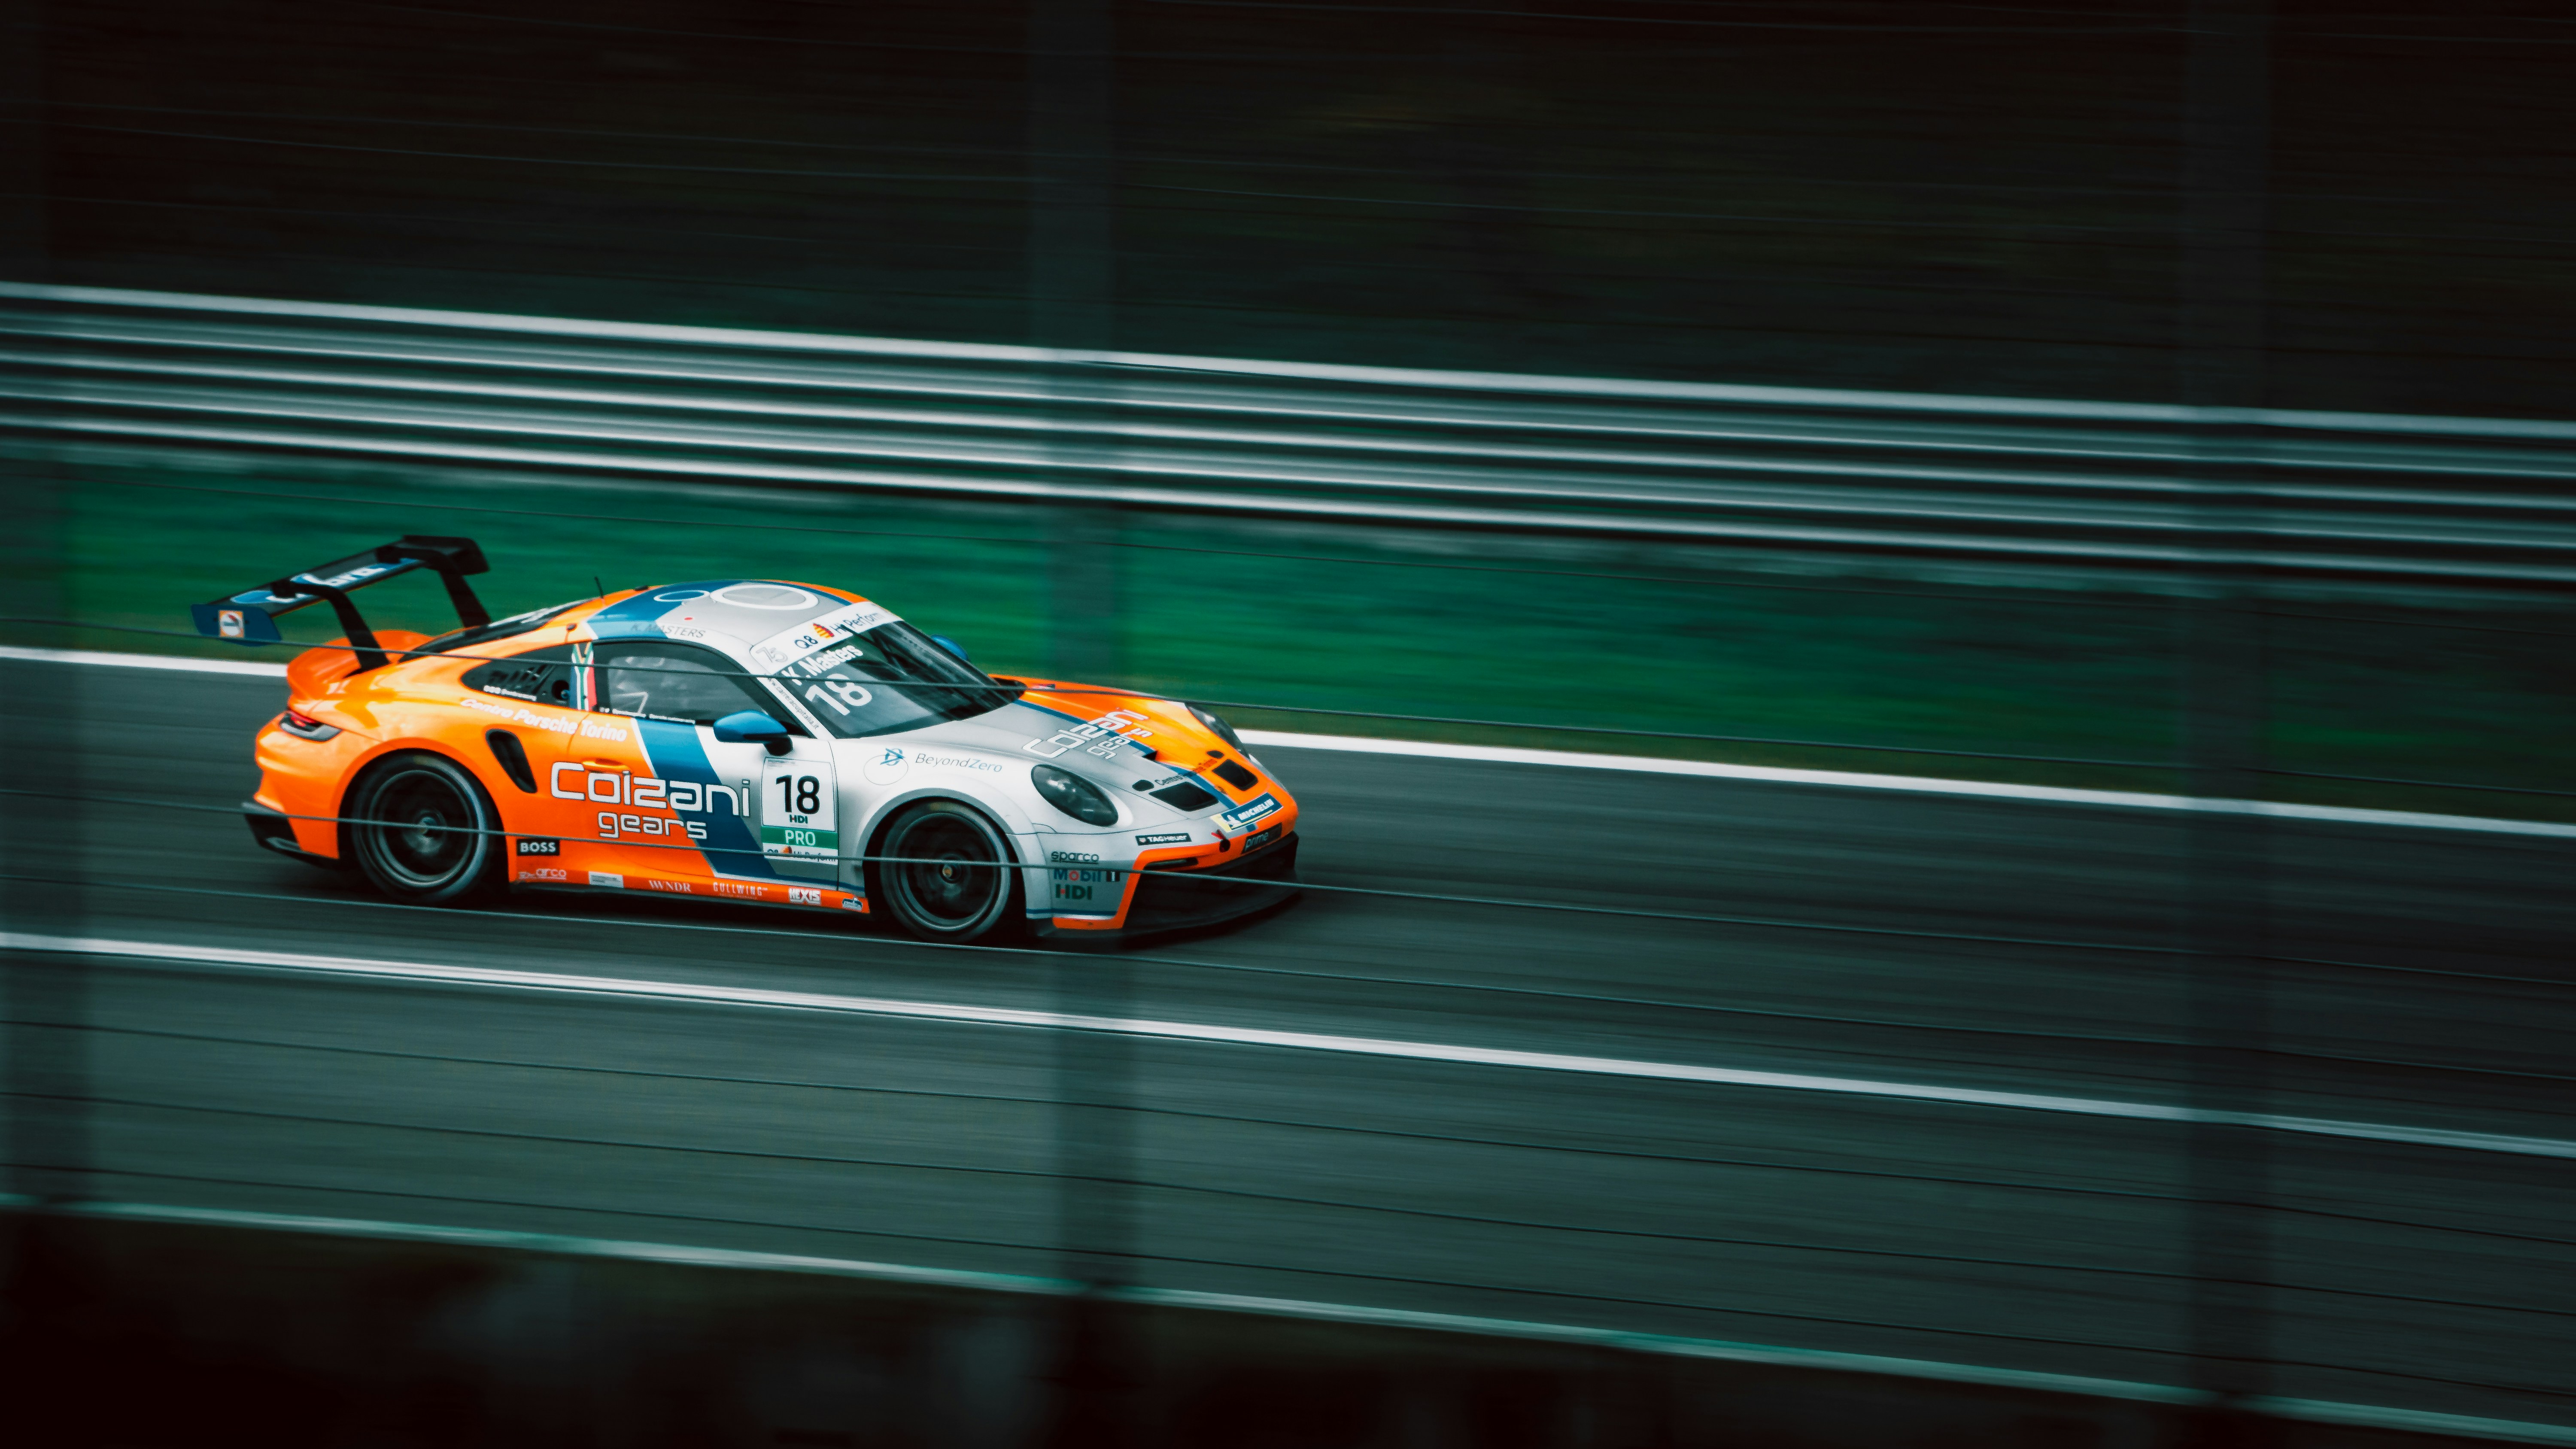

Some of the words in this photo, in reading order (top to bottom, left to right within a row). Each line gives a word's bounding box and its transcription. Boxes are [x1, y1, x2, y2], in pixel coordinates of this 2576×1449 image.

[794, 635, 818, 649] Q8
[829, 623, 848, 634] H
[805, 673, 872, 716] 18
[460, 699, 514, 718] Centro
[513, 709, 578, 735] Porsche
[580, 719, 628, 742] Torino
[1022, 708, 1149, 758] Colzani
[1086, 728, 1154, 760] gears
[915, 753, 1002, 773] BeyondZero
[551, 761, 750, 817] Colzani
[775, 774, 820, 815] 18
[789, 814, 808, 824] HDI
[1237, 799, 1274, 821] MICHELIN
[598, 811, 708, 840] gears
[520, 842, 556, 853] BOSS
[785, 829, 816, 846] PRO
[1051, 851, 1100, 863] sparco
[1054, 869, 1101, 882] Mobil
[789, 888, 820, 905] HEXIS
[1055, 883, 1093, 900] HDI
